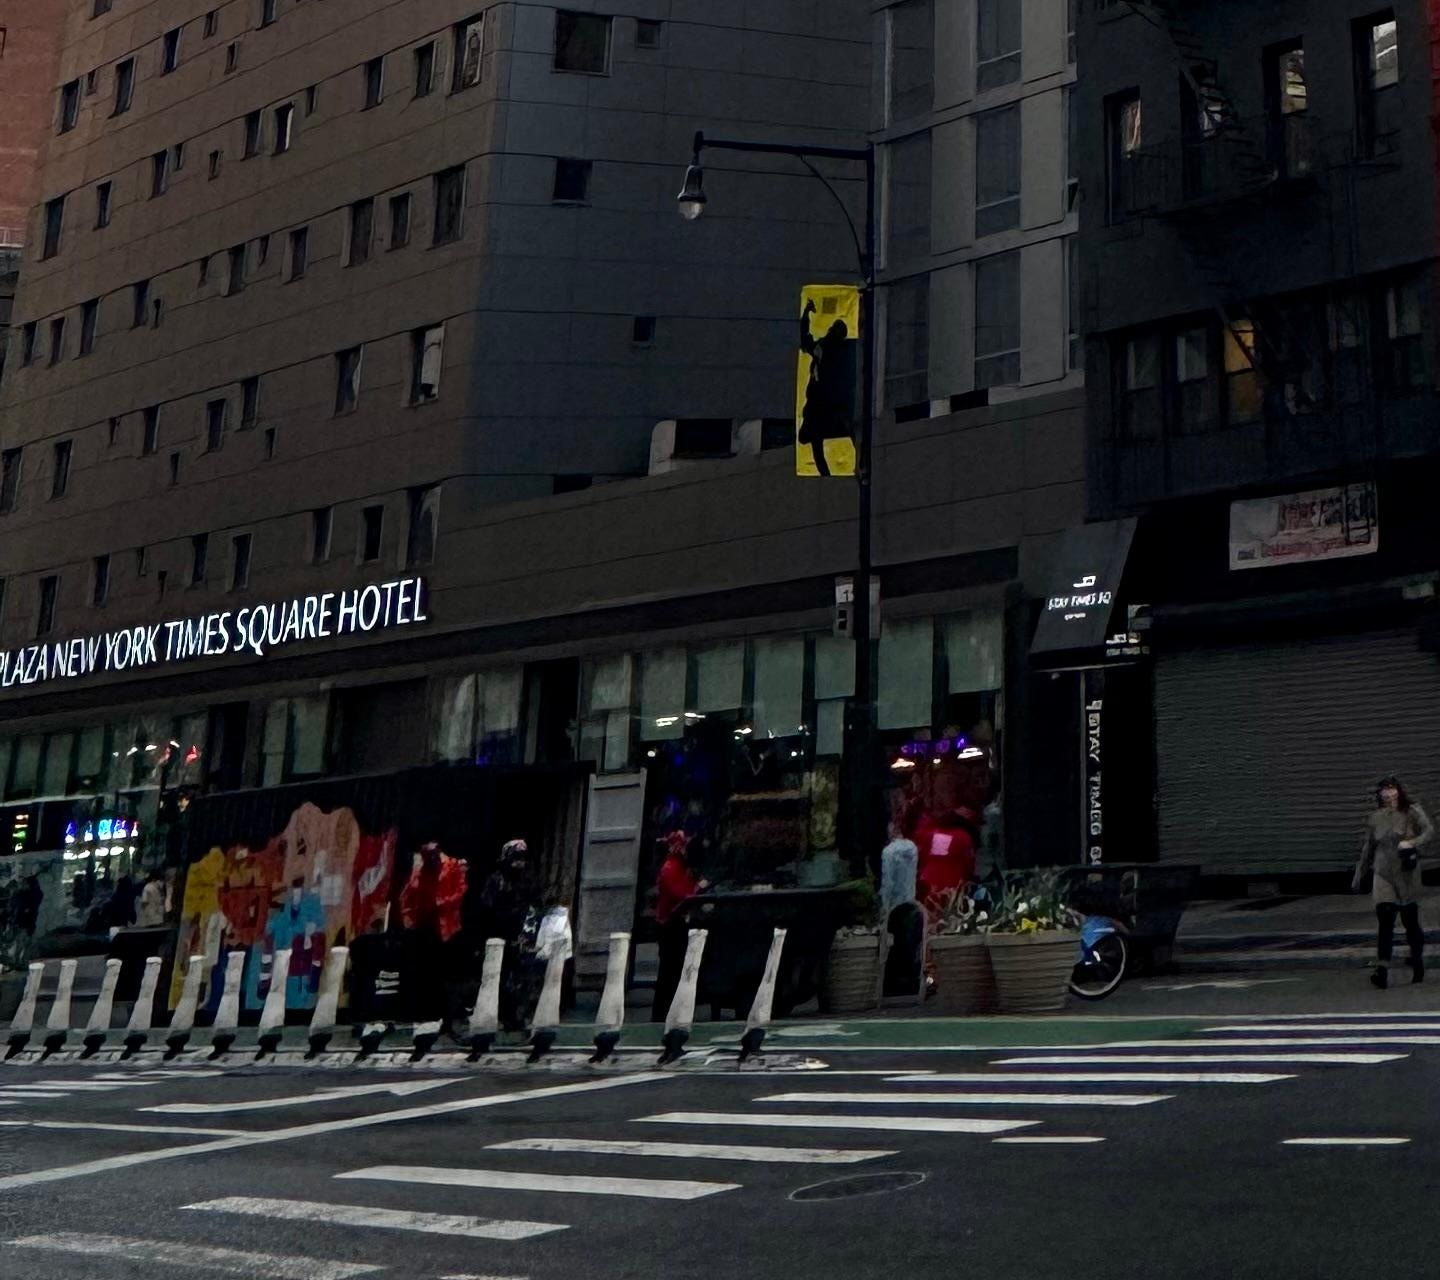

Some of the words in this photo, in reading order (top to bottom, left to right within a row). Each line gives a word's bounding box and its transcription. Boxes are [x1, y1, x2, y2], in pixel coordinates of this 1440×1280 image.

[51, 634, 102, 679] NEW
[104, 624, 161, 671] YORK
[165, 612, 231, 660] TIMES
[233, 593, 335, 656] SQUARE
[337, 577, 427, 634] HOTEL
